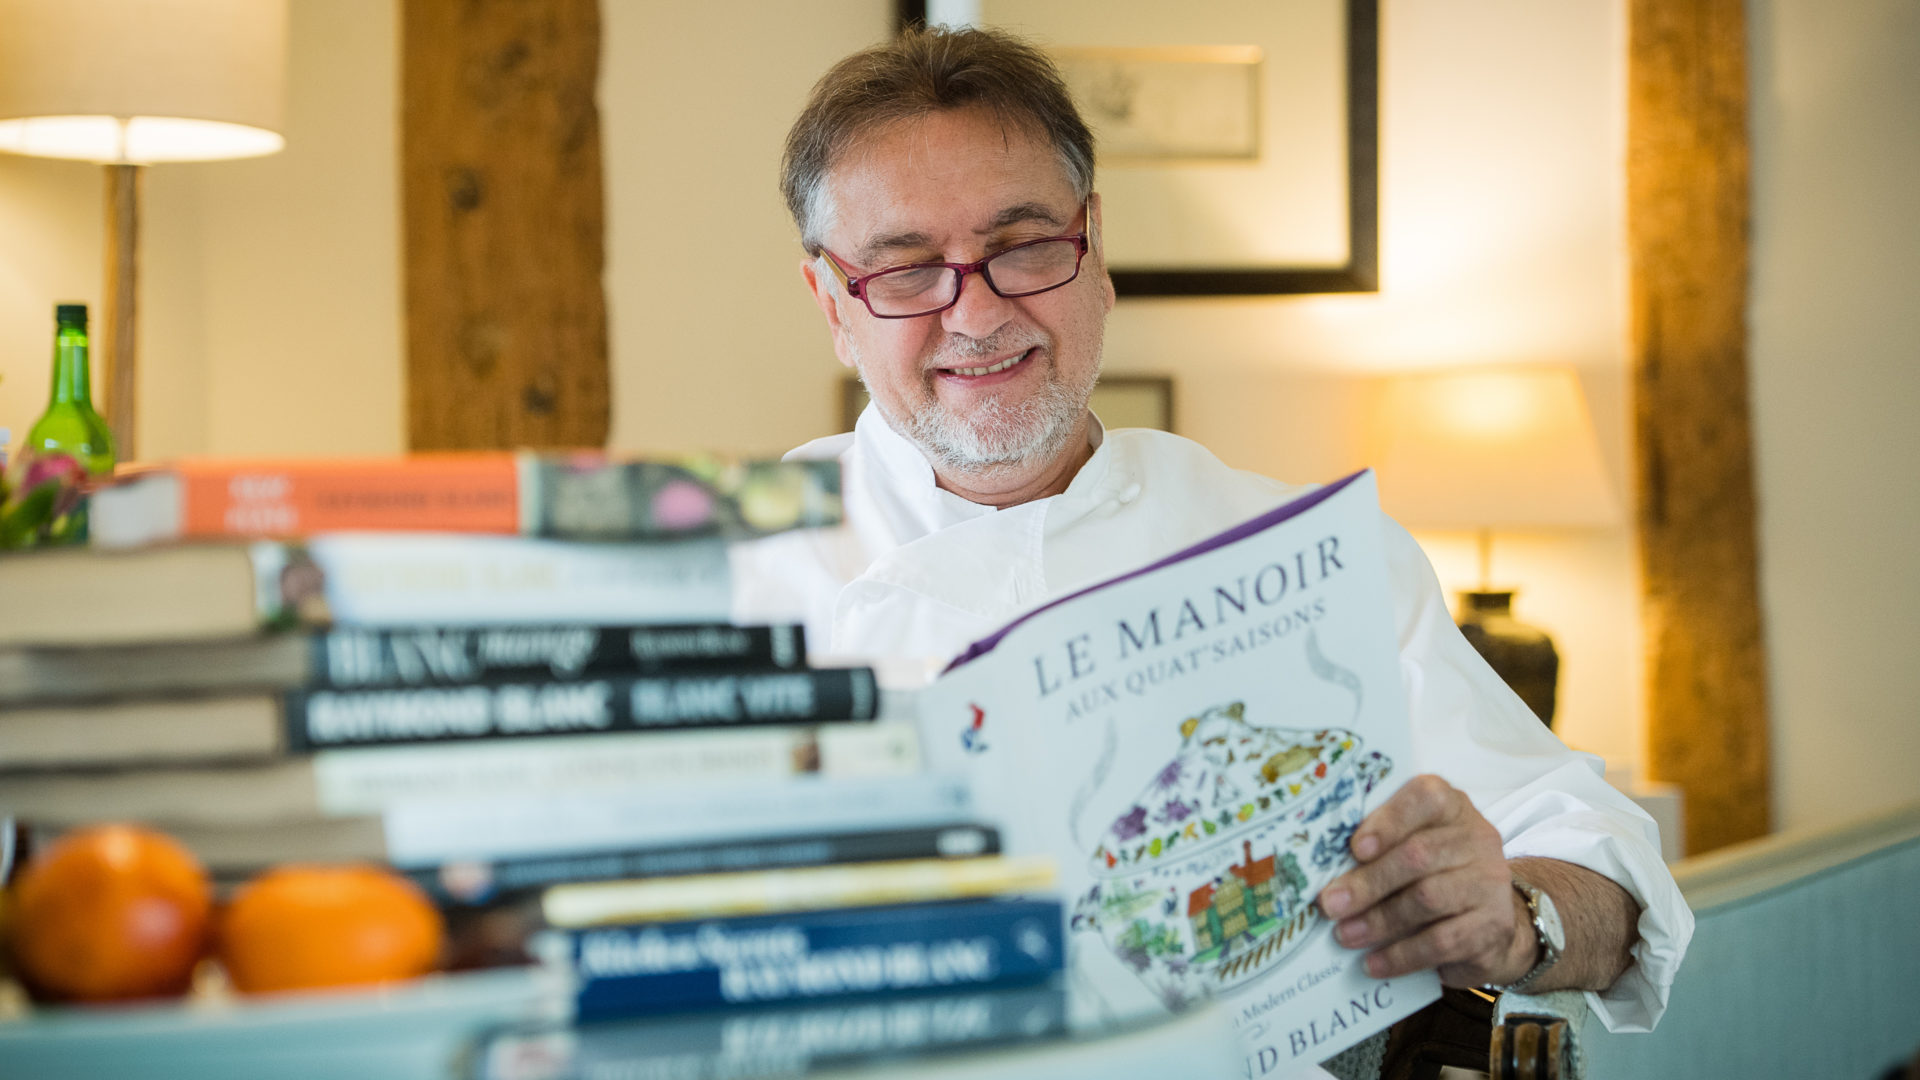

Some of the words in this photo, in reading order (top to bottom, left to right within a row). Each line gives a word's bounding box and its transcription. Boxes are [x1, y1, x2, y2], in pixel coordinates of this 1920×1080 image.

[1034, 634, 1095, 696] LE
[1117, 536, 1345, 660] MANOIR
[1066, 681, 1119, 723] AUX
[1242, 987, 1296, 1024] Modern
[1296, 960, 1343, 993] Classic
[1289, 980, 1393, 1058] BLANC
